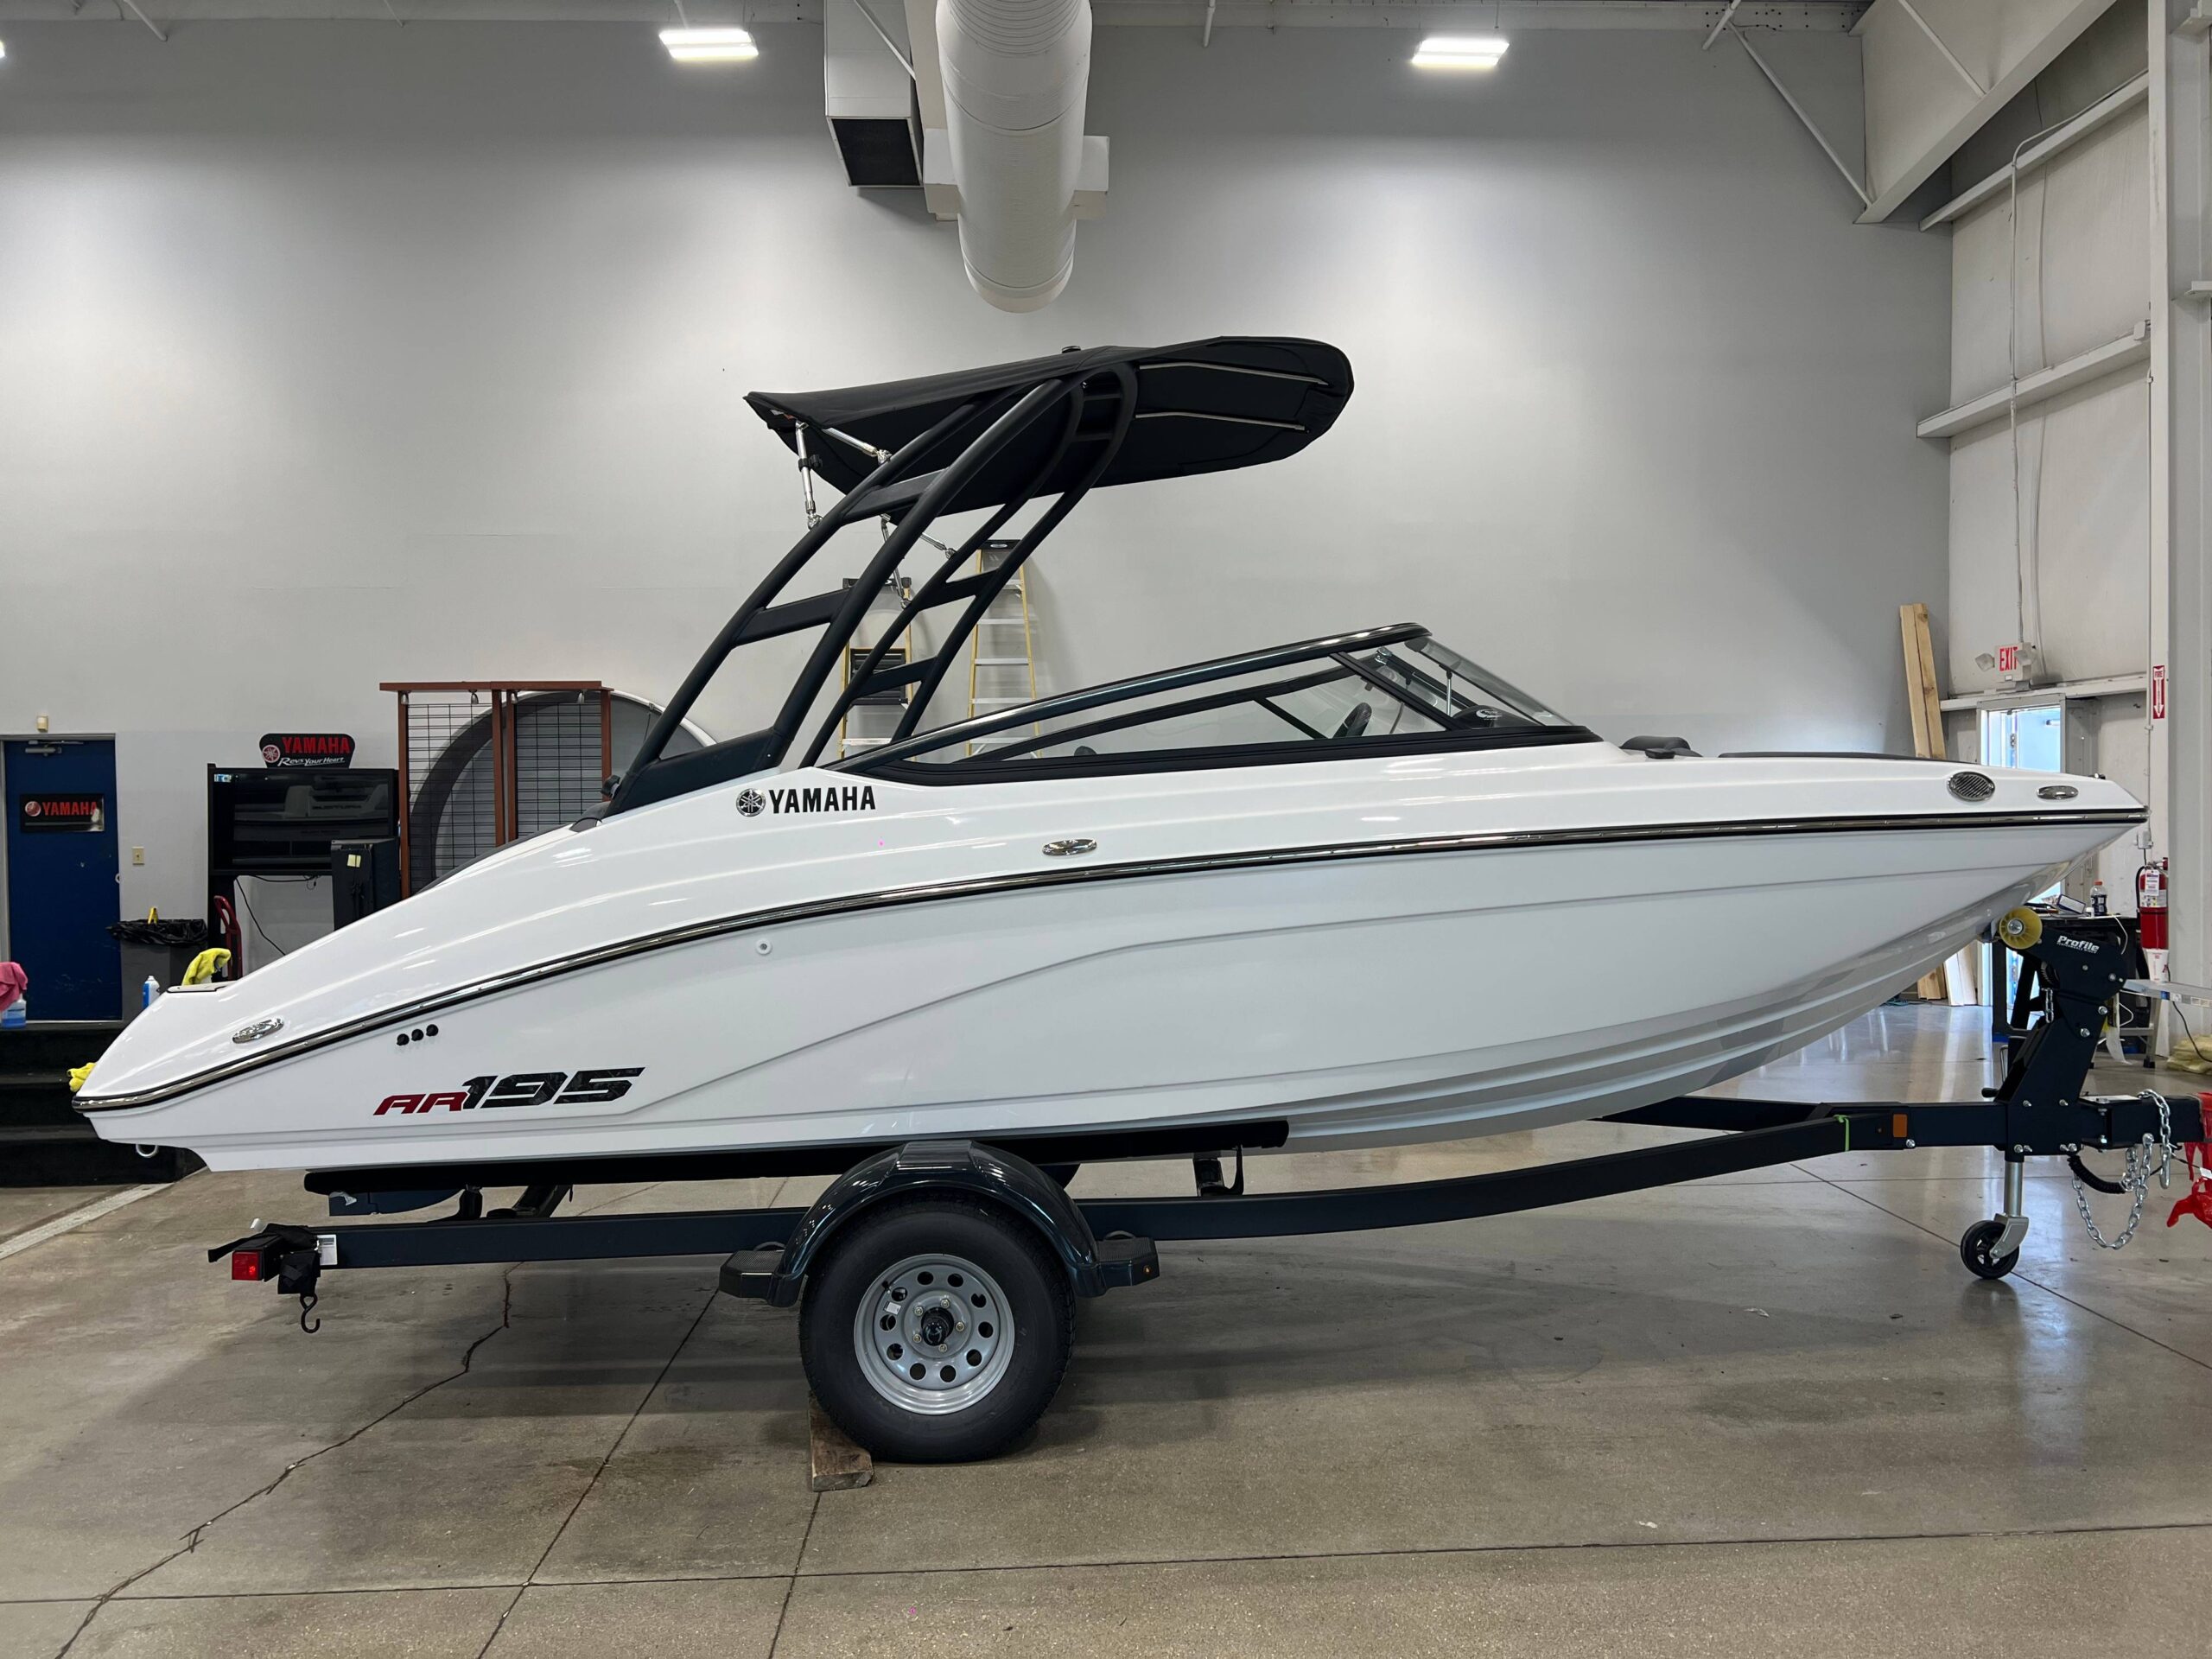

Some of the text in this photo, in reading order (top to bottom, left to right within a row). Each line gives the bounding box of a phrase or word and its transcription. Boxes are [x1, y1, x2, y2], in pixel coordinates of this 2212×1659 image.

[1999, 646, 2018, 671] EXIT
[282, 736, 351, 754] YAMAHA
[277, 757, 304, 767] Revs
[304, 758, 323, 766] Your
[768, 785, 876, 814] YAMAHA
[41, 801, 98, 816] YAMAHA
[2056, 935, 2100, 951] Profile
